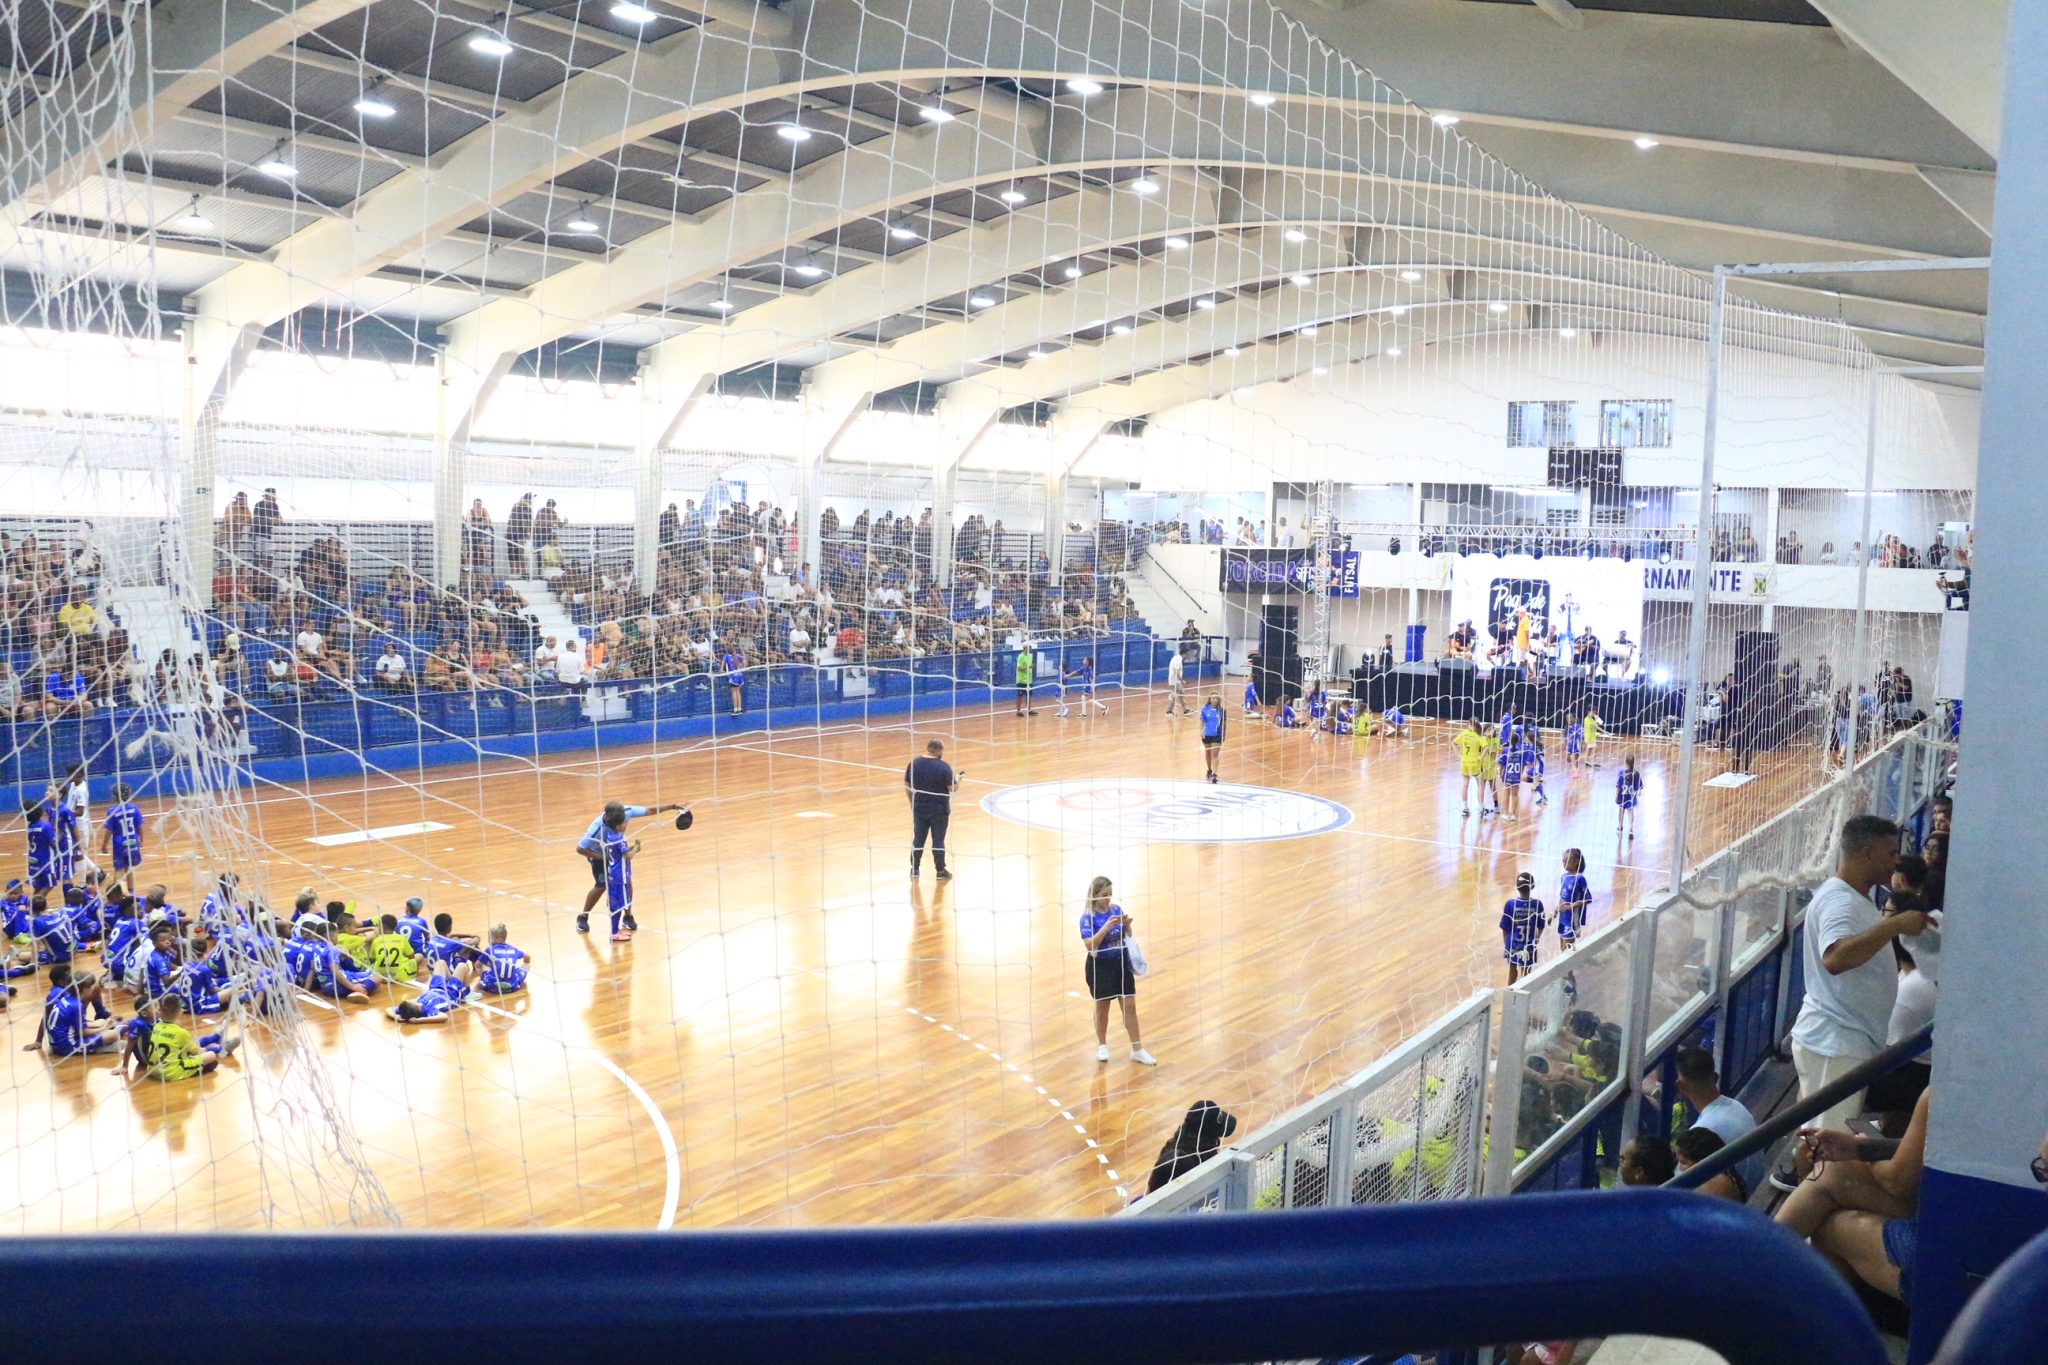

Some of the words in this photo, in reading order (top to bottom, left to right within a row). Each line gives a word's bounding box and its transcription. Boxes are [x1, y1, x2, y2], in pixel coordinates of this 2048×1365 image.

[1224, 559, 1298, 583] TORCIDA
[1344, 557, 1357, 593] FUTSAL
[1493, 585, 1547, 617] Pagode
[1507, 762, 1521, 774] 20
[119, 816, 136, 837] 13
[108, 927, 121, 946] 9
[295, 952, 305, 973] 8
[378, 947, 400, 968] 22
